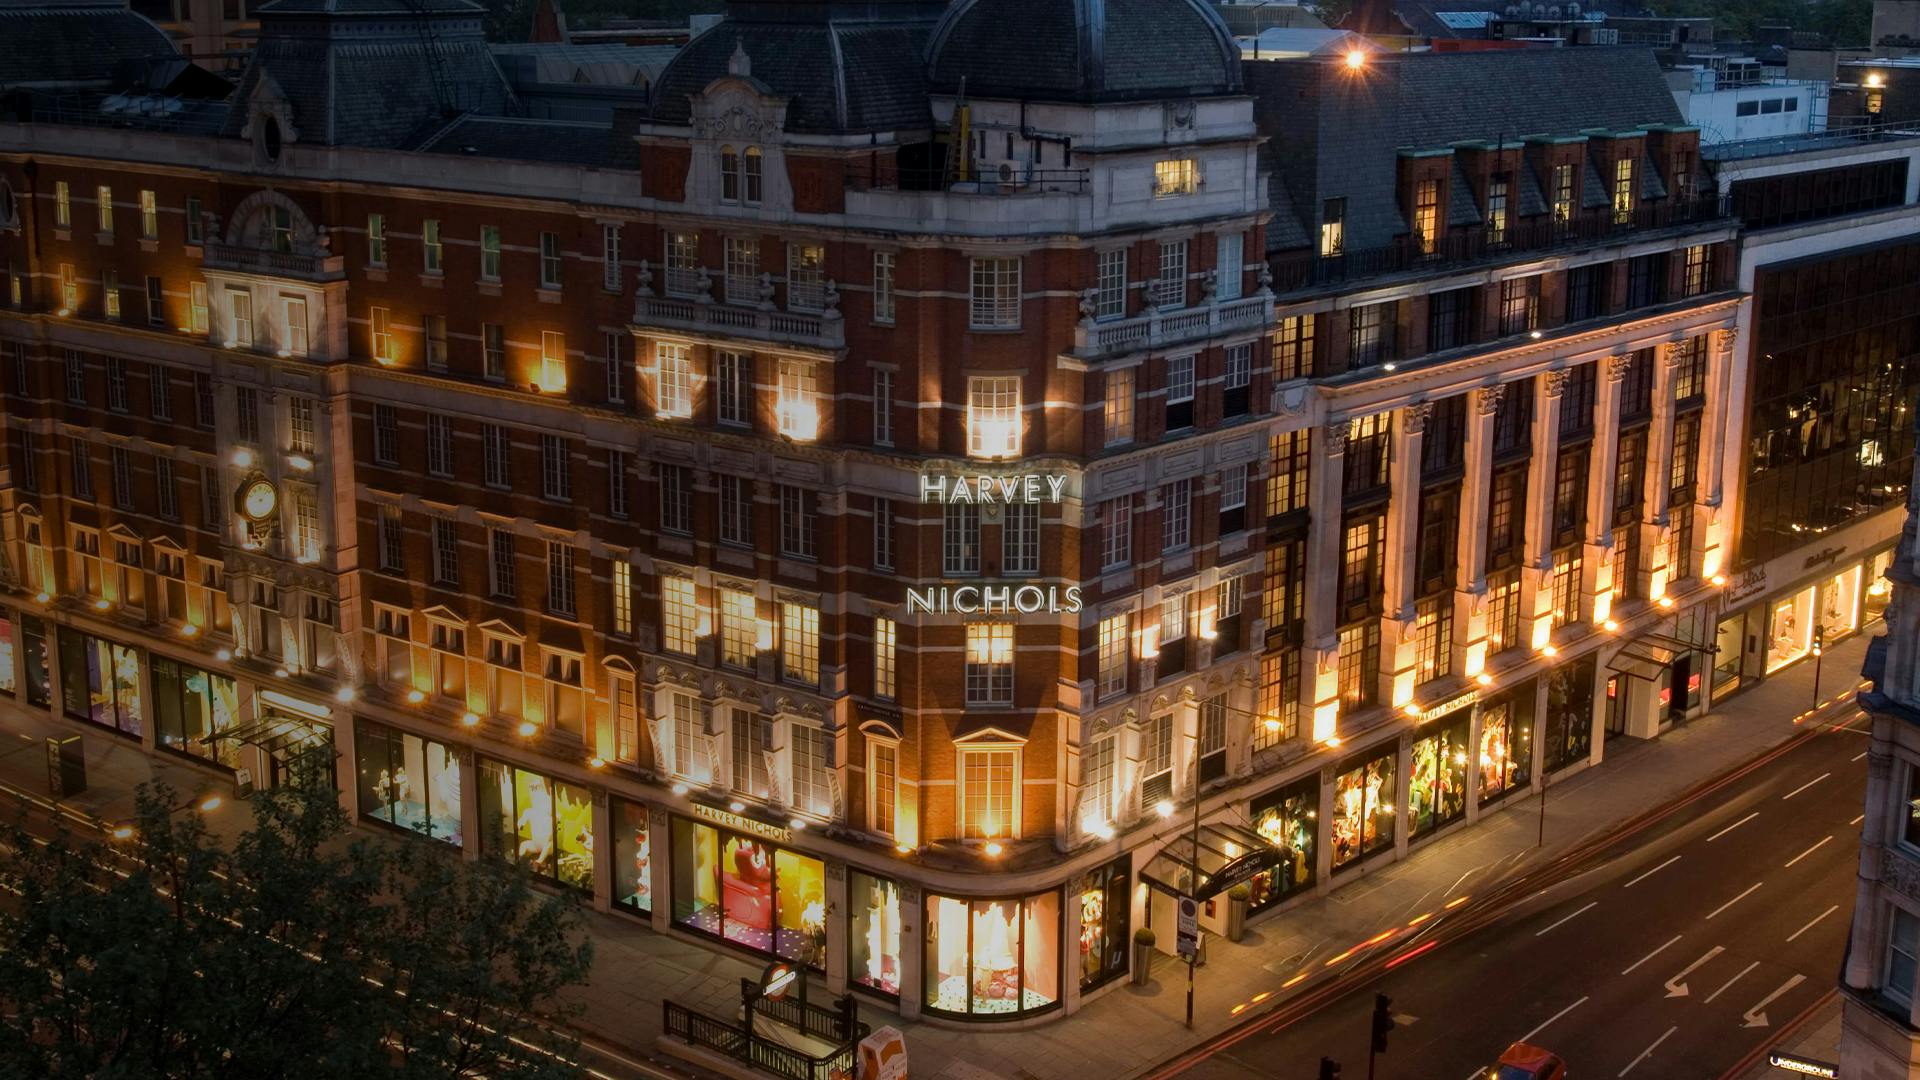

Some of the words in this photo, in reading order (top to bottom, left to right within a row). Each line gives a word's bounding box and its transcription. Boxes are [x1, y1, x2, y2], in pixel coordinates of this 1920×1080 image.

[921, 475, 1067, 504] HARVEY
[907, 585, 1083, 616] NICHOLS
[694, 804, 737, 825] HARVEY
[742, 817, 792, 842] NICHOLS
[1770, 1056, 1838, 1079] UNDERGROUND
